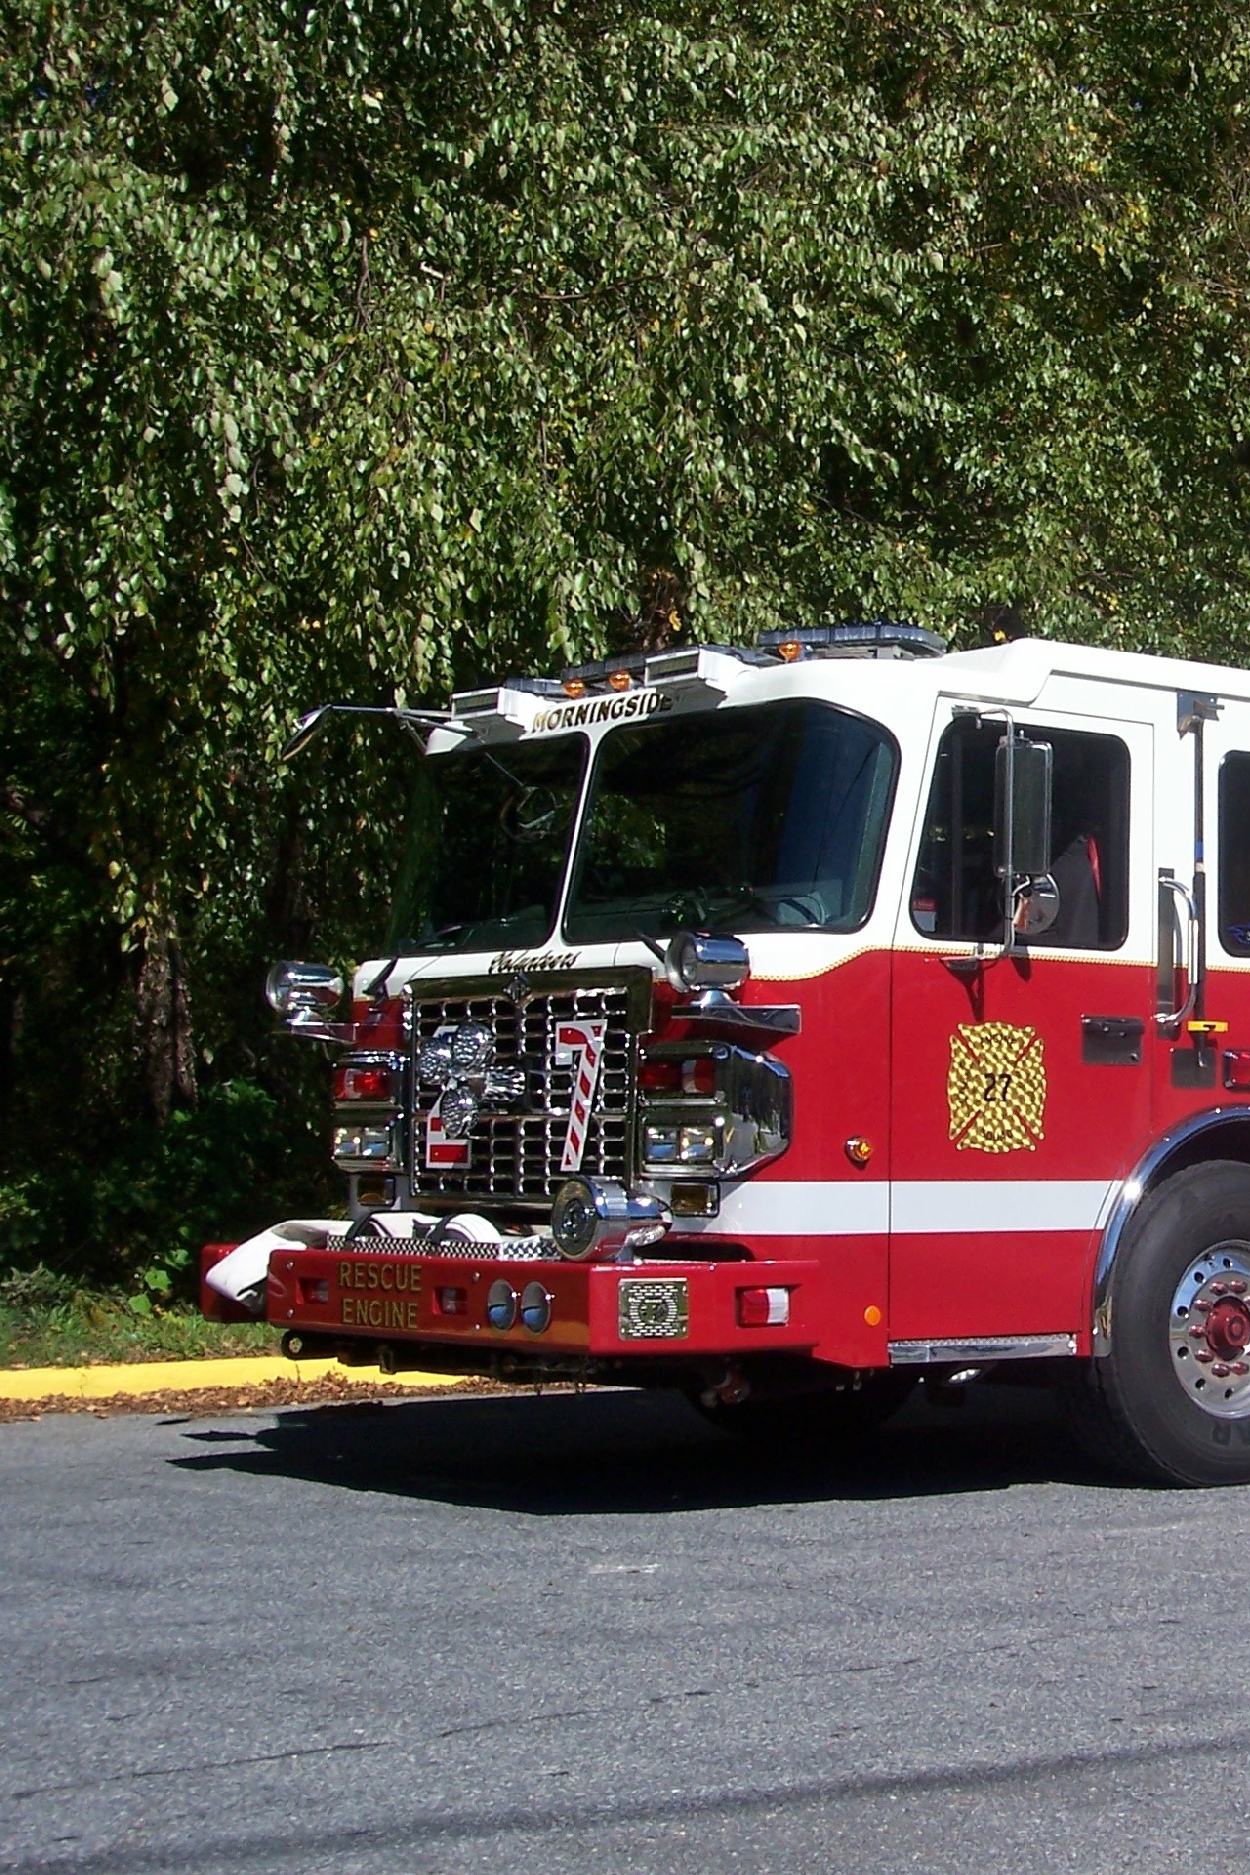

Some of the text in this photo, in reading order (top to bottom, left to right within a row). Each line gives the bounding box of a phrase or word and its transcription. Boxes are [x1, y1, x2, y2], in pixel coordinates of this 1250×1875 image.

[531, 692, 673, 734] MORNINGSIDE
[984, 1073, 1012, 1101] 27
[337, 1261, 422, 1292] RESCUE
[342, 1297, 418, 1329] ENGINE
